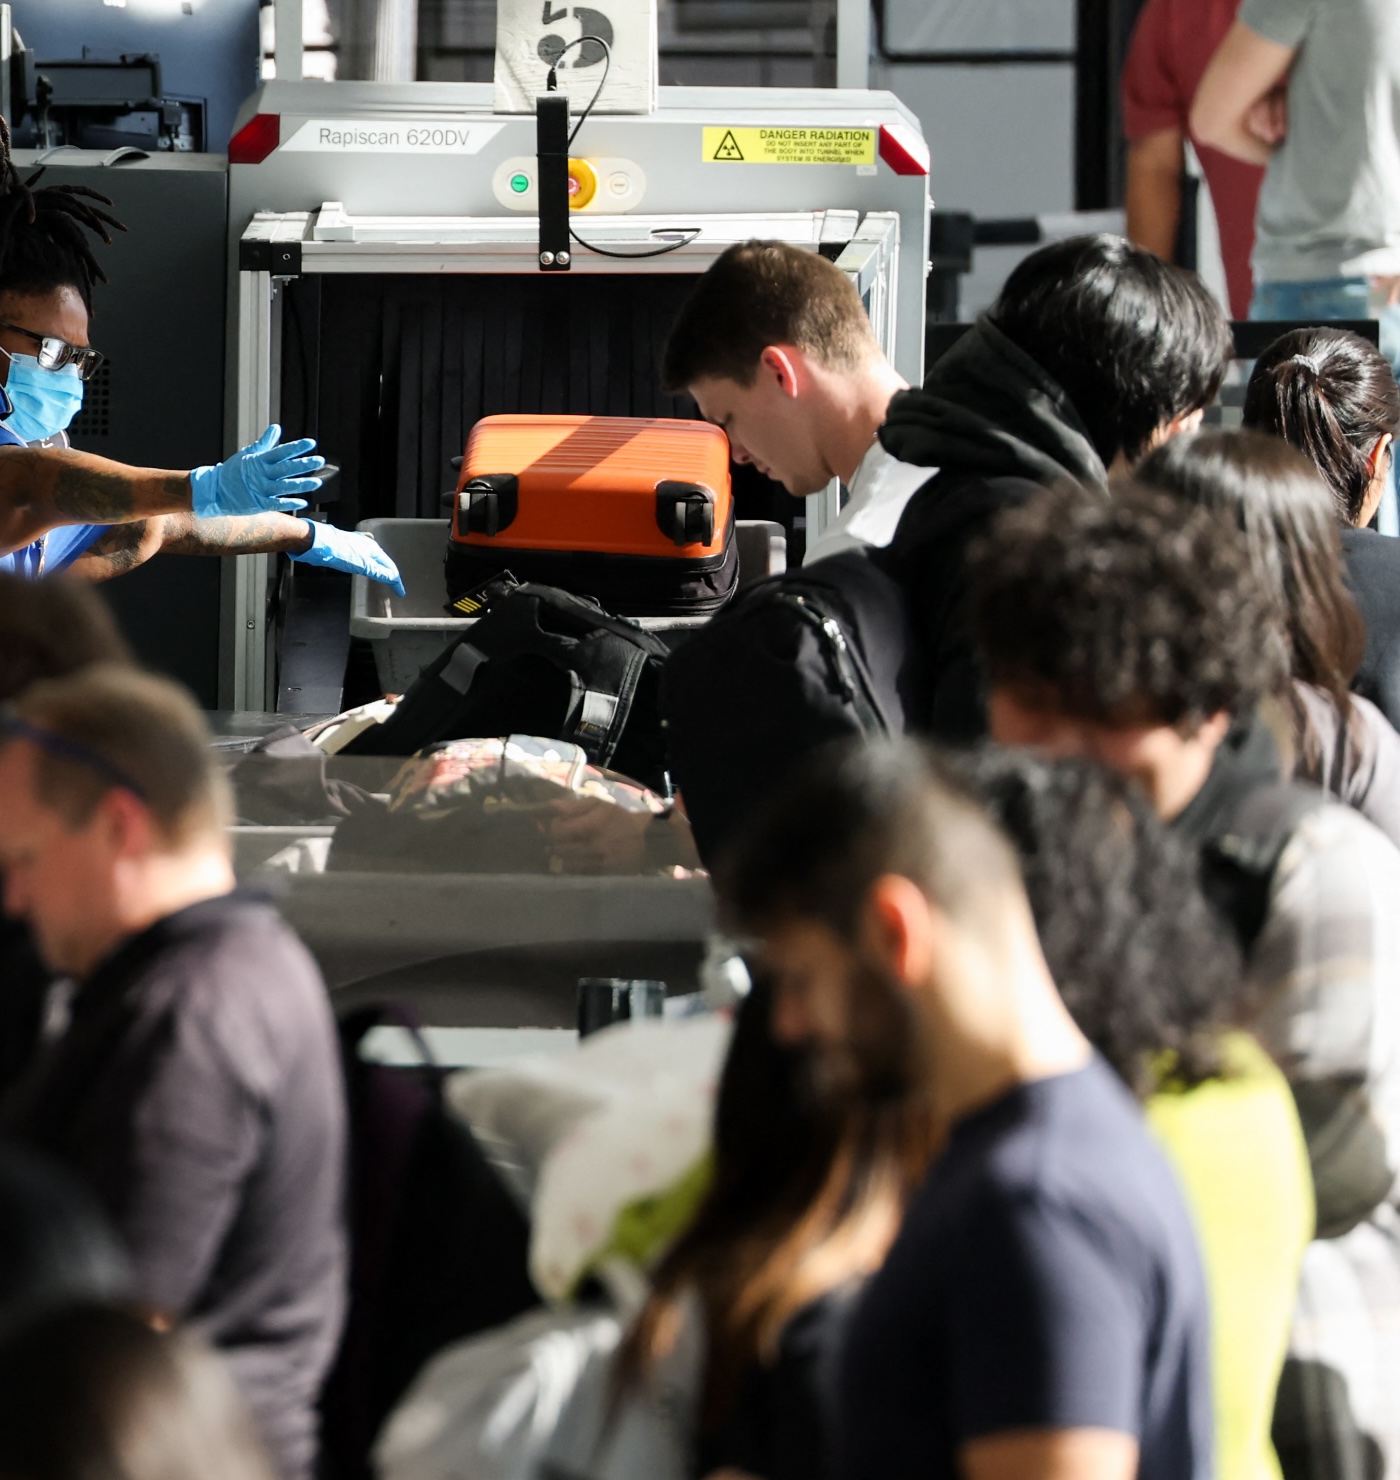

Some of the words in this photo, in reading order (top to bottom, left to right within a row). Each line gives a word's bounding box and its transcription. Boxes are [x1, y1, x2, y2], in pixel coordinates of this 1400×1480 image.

[537, 1, 614, 69] 5
[319, 128, 399, 147] Rapiscan
[407, 129, 470, 146] 620DV
[759, 130, 806, 140] DANGER
[810, 130, 869, 141] RADIATION
